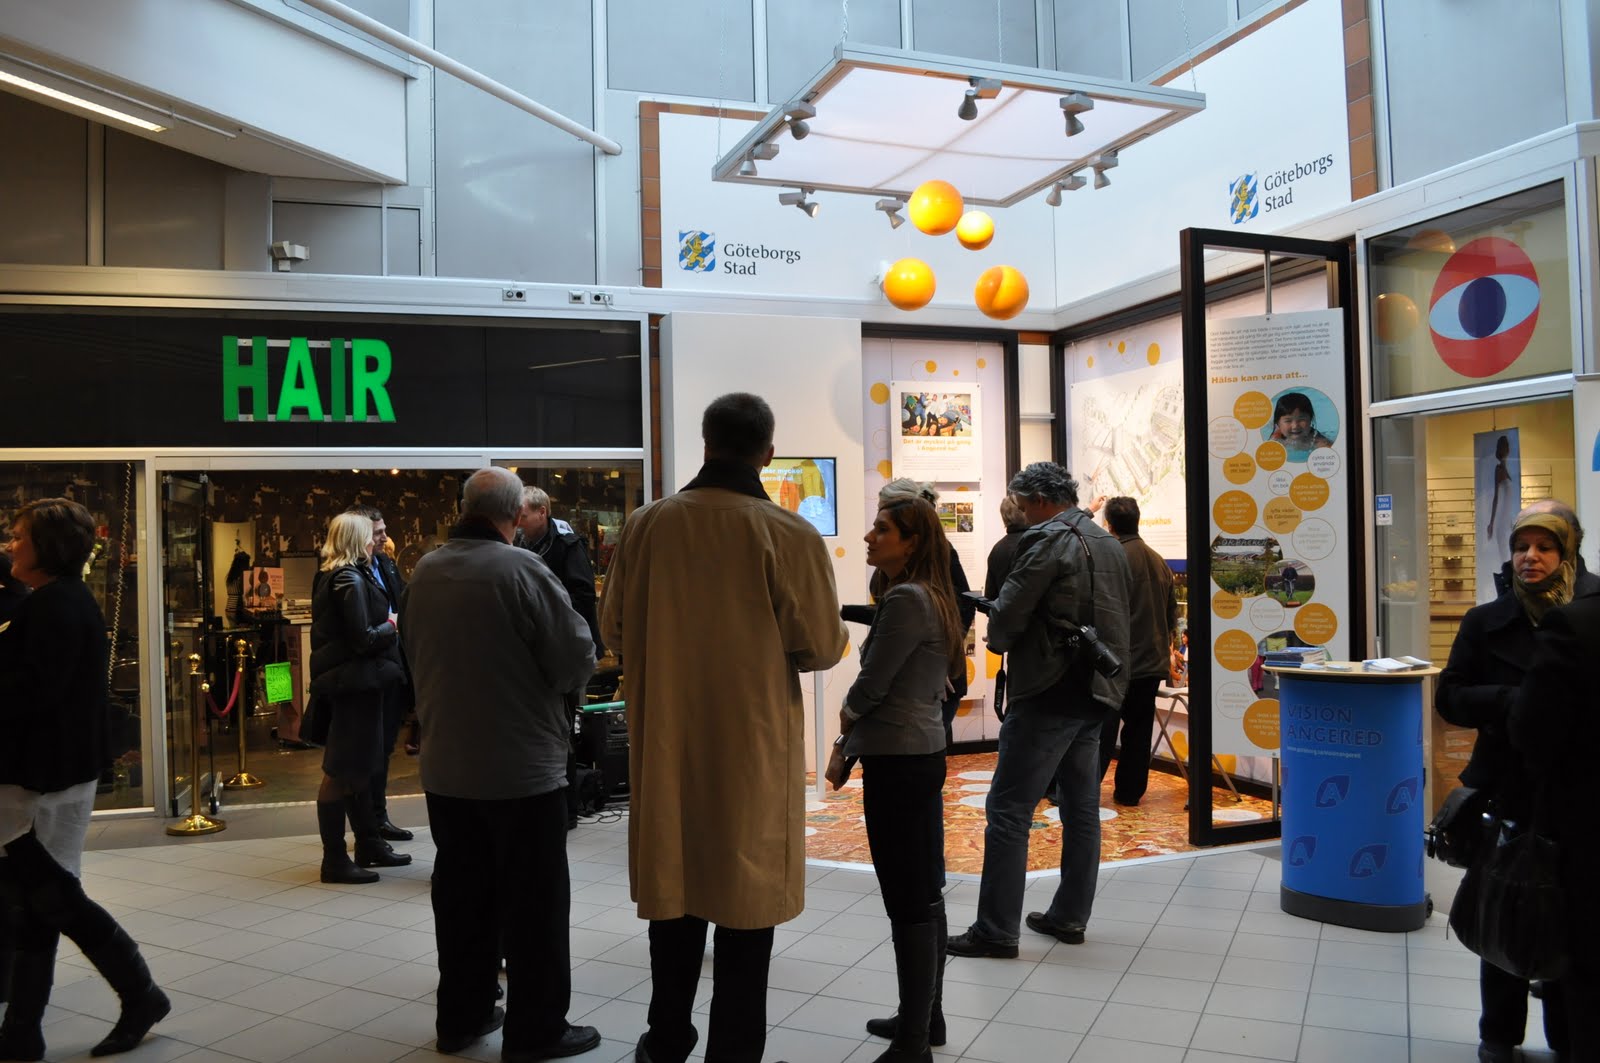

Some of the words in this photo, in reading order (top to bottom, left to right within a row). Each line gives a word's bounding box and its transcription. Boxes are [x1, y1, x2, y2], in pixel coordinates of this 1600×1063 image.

[1264, 154, 1334, 191] Göteborgs
[1265, 187, 1293, 213] Stad
[723, 243, 801, 264] Göteborgs
[724, 261, 757, 275] Stad
[222, 336, 397, 423] HAIR
[1211, 375, 1238, 384] Hälsa
[1241, 373, 1258, 382] kan
[1139, 517, 1171, 526] rsjukhus
[1287, 704, 1353, 724] VISION
[1287, 724, 1383, 746] ANGERED
